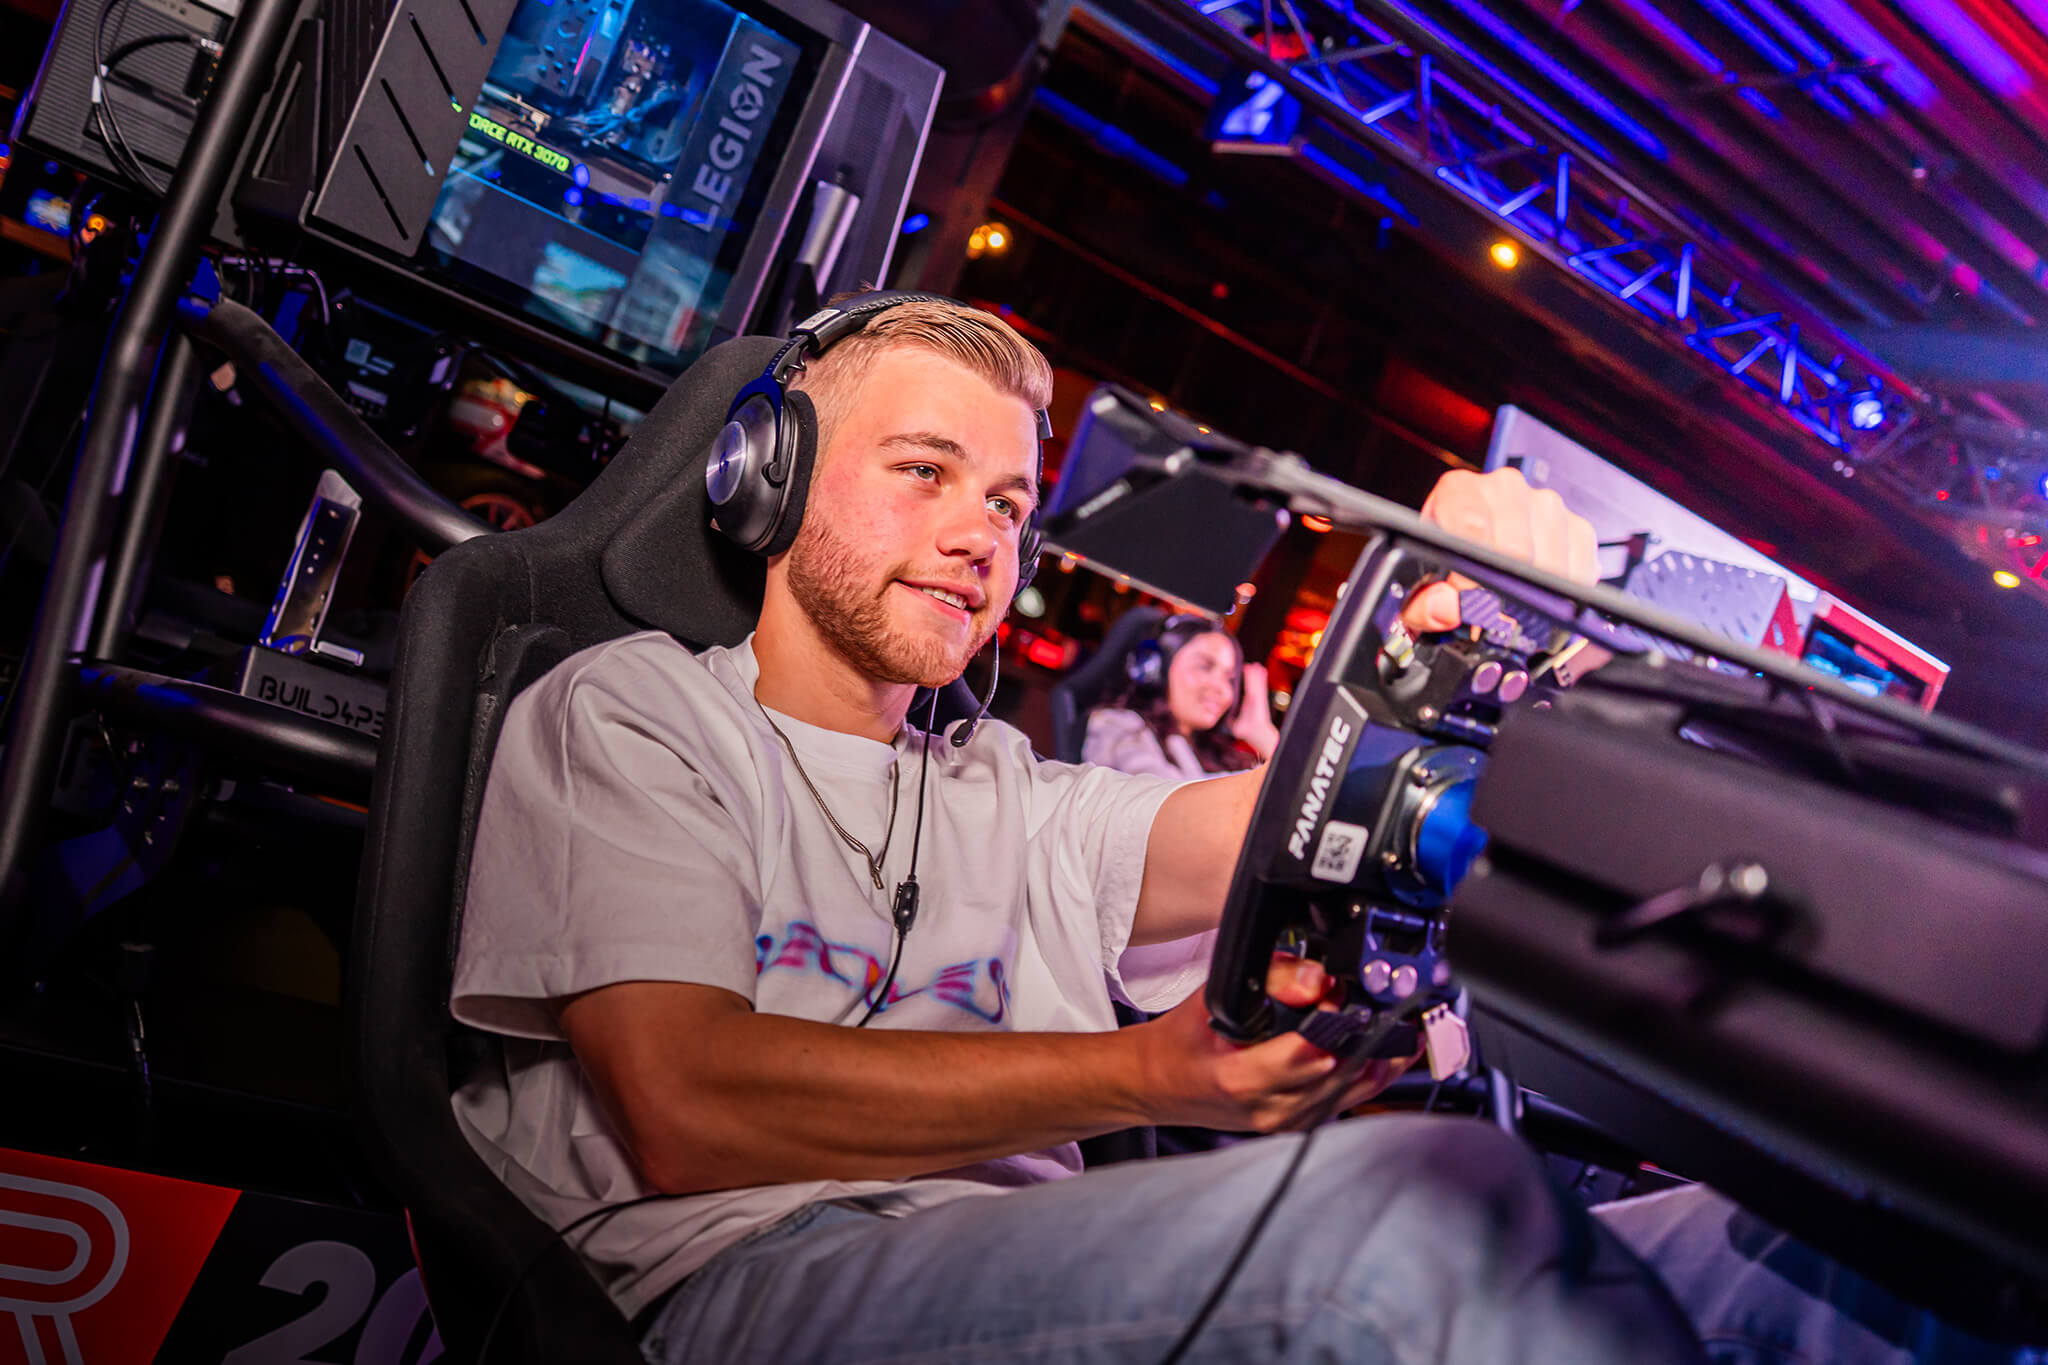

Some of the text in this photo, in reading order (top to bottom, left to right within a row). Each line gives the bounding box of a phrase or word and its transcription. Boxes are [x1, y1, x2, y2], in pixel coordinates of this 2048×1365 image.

[468, 111, 570, 173] ORCE RTX 3070
[680, 43, 783, 233] LEGION
[1288, 716, 1351, 860] FANATEC
